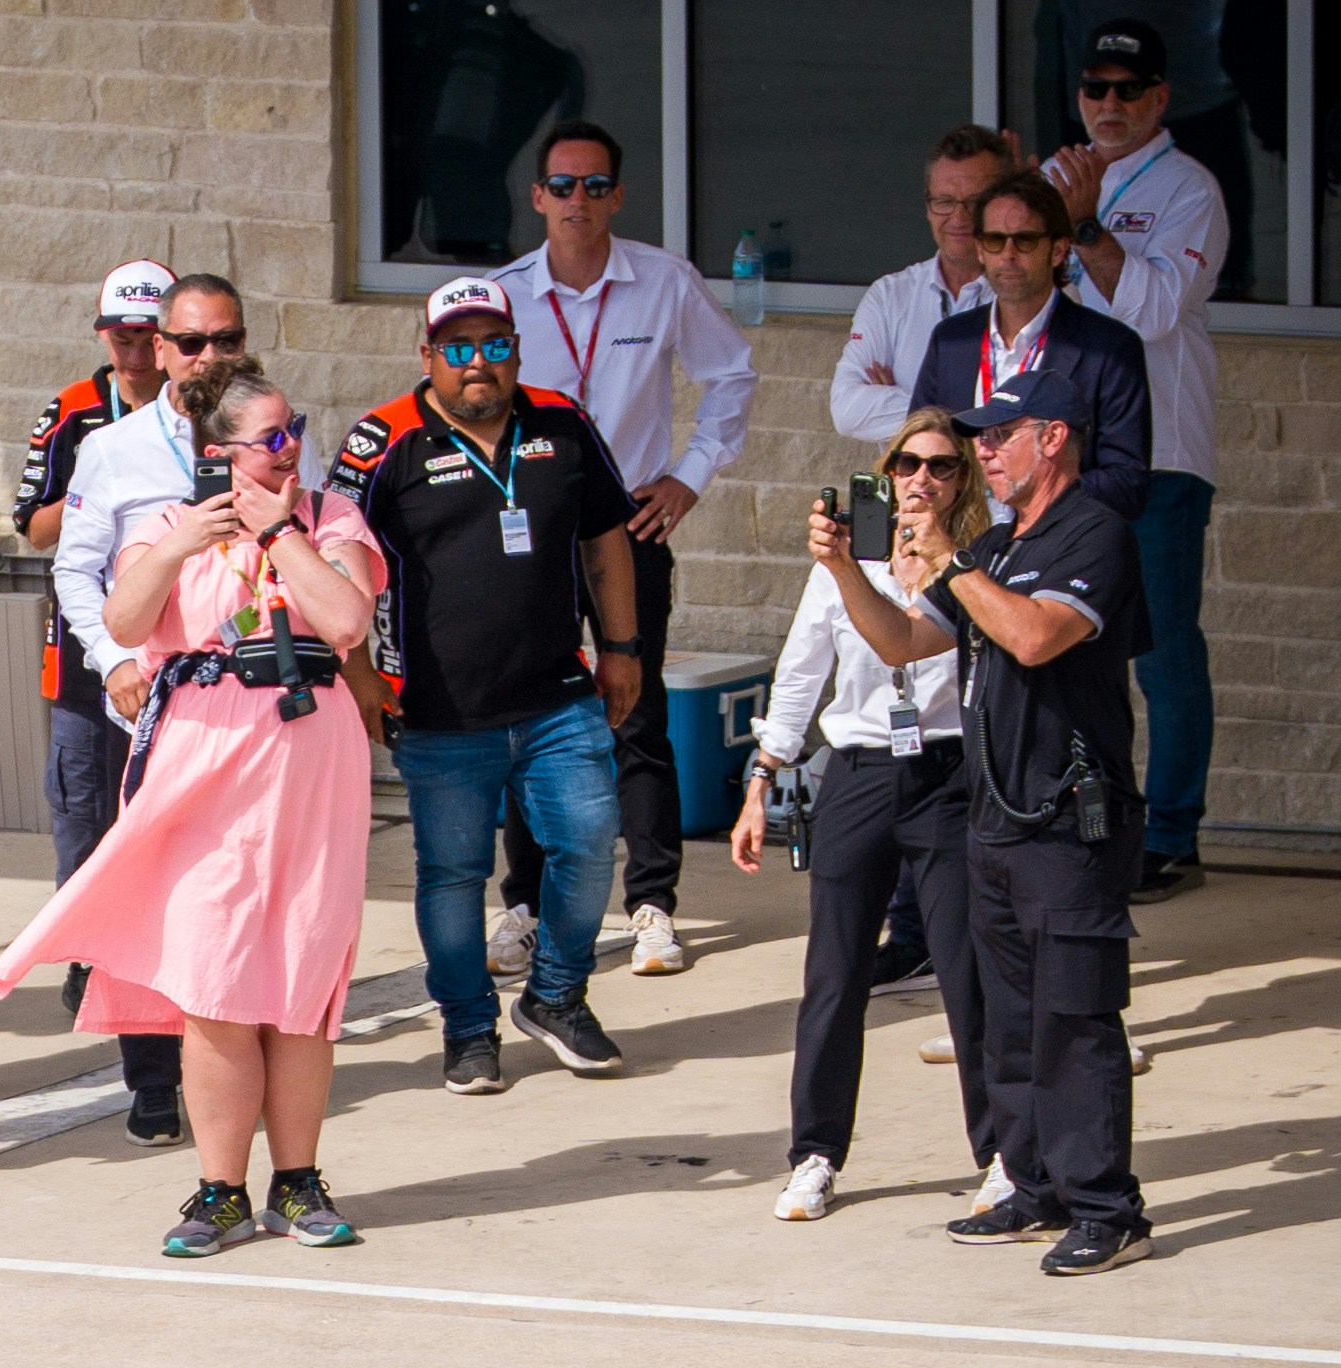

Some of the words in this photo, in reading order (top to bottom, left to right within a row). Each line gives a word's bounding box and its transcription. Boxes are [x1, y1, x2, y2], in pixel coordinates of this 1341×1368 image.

[115, 281, 161, 299] aprilia
[442, 284, 490, 306] aprilia
[436, 455, 464, 467] Castrol
[428, 471, 460, 484] CASE
